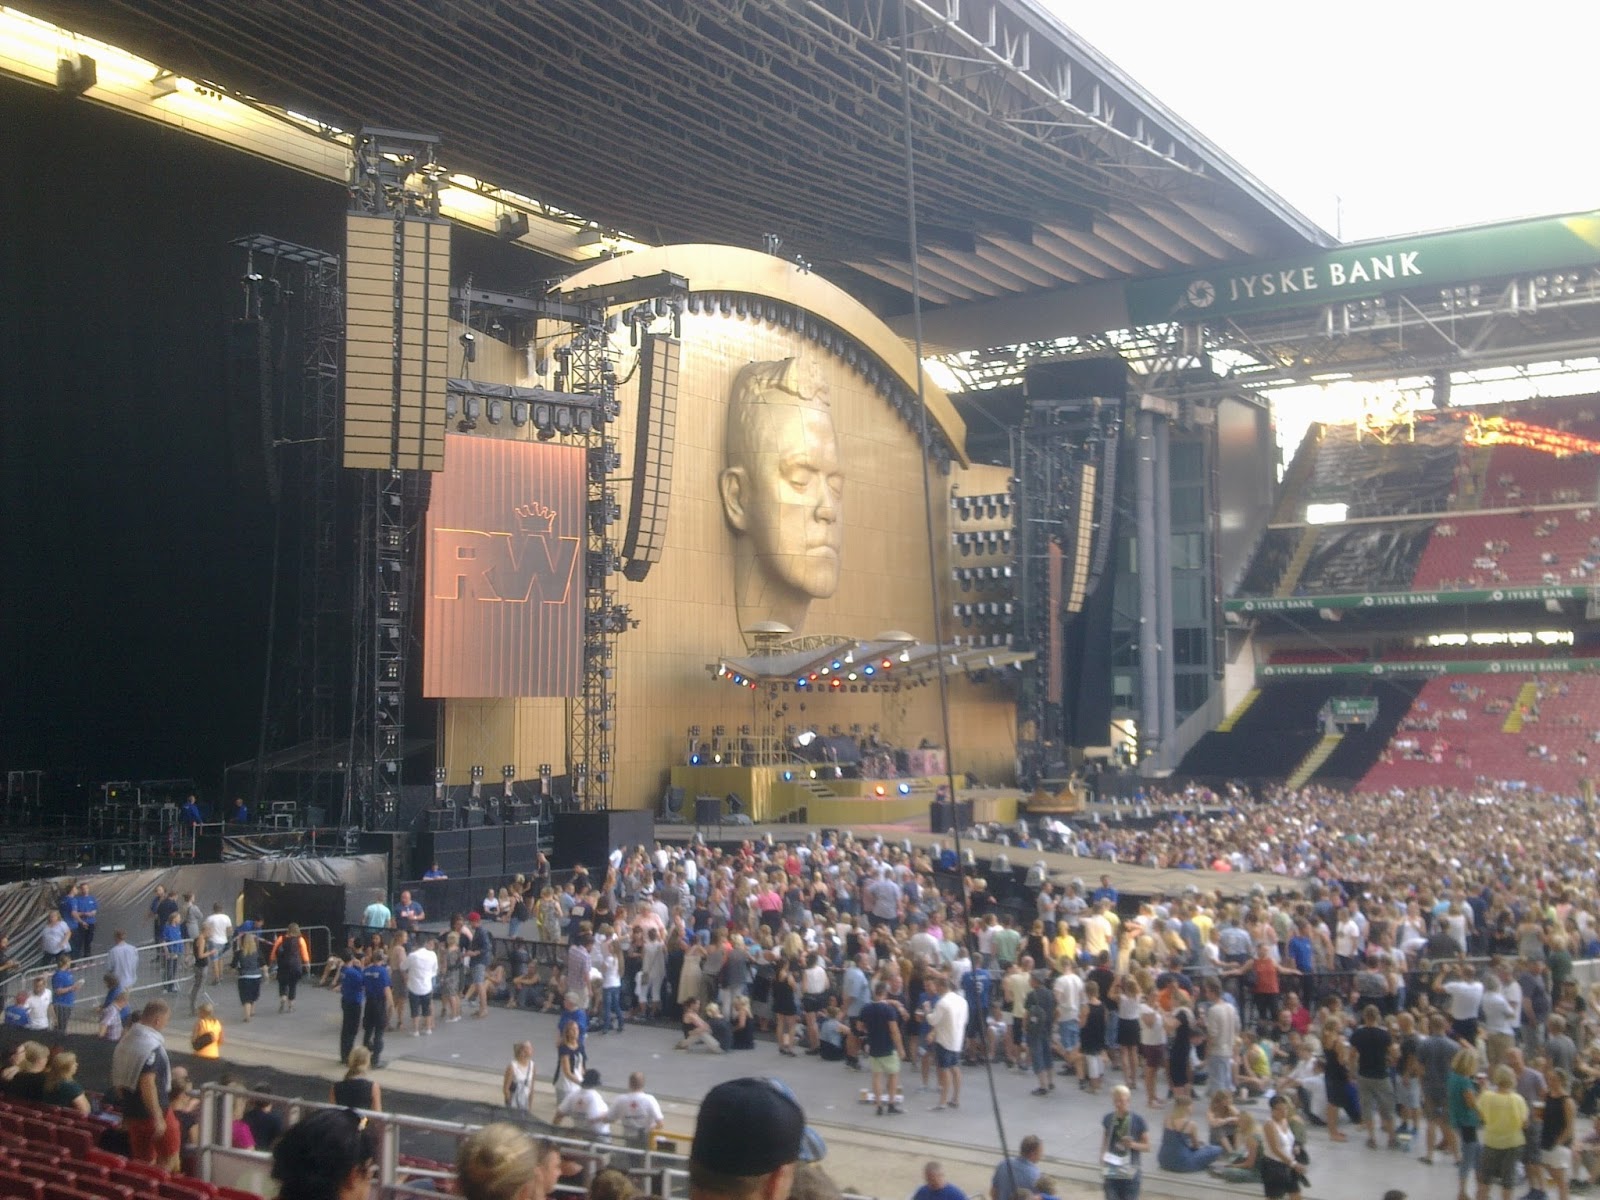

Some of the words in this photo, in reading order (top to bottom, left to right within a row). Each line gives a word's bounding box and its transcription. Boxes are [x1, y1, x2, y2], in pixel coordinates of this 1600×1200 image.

[1230, 267, 1318, 301] JYSKE
[1329, 251, 1422, 287] BANK
[434, 528, 580, 604] RW
[1409, 594, 1439, 604] BANK
[1542, 588, 1574, 599] BANK
[1287, 600, 1314, 609] BANK
[1539, 660, 1570, 671] BANK
